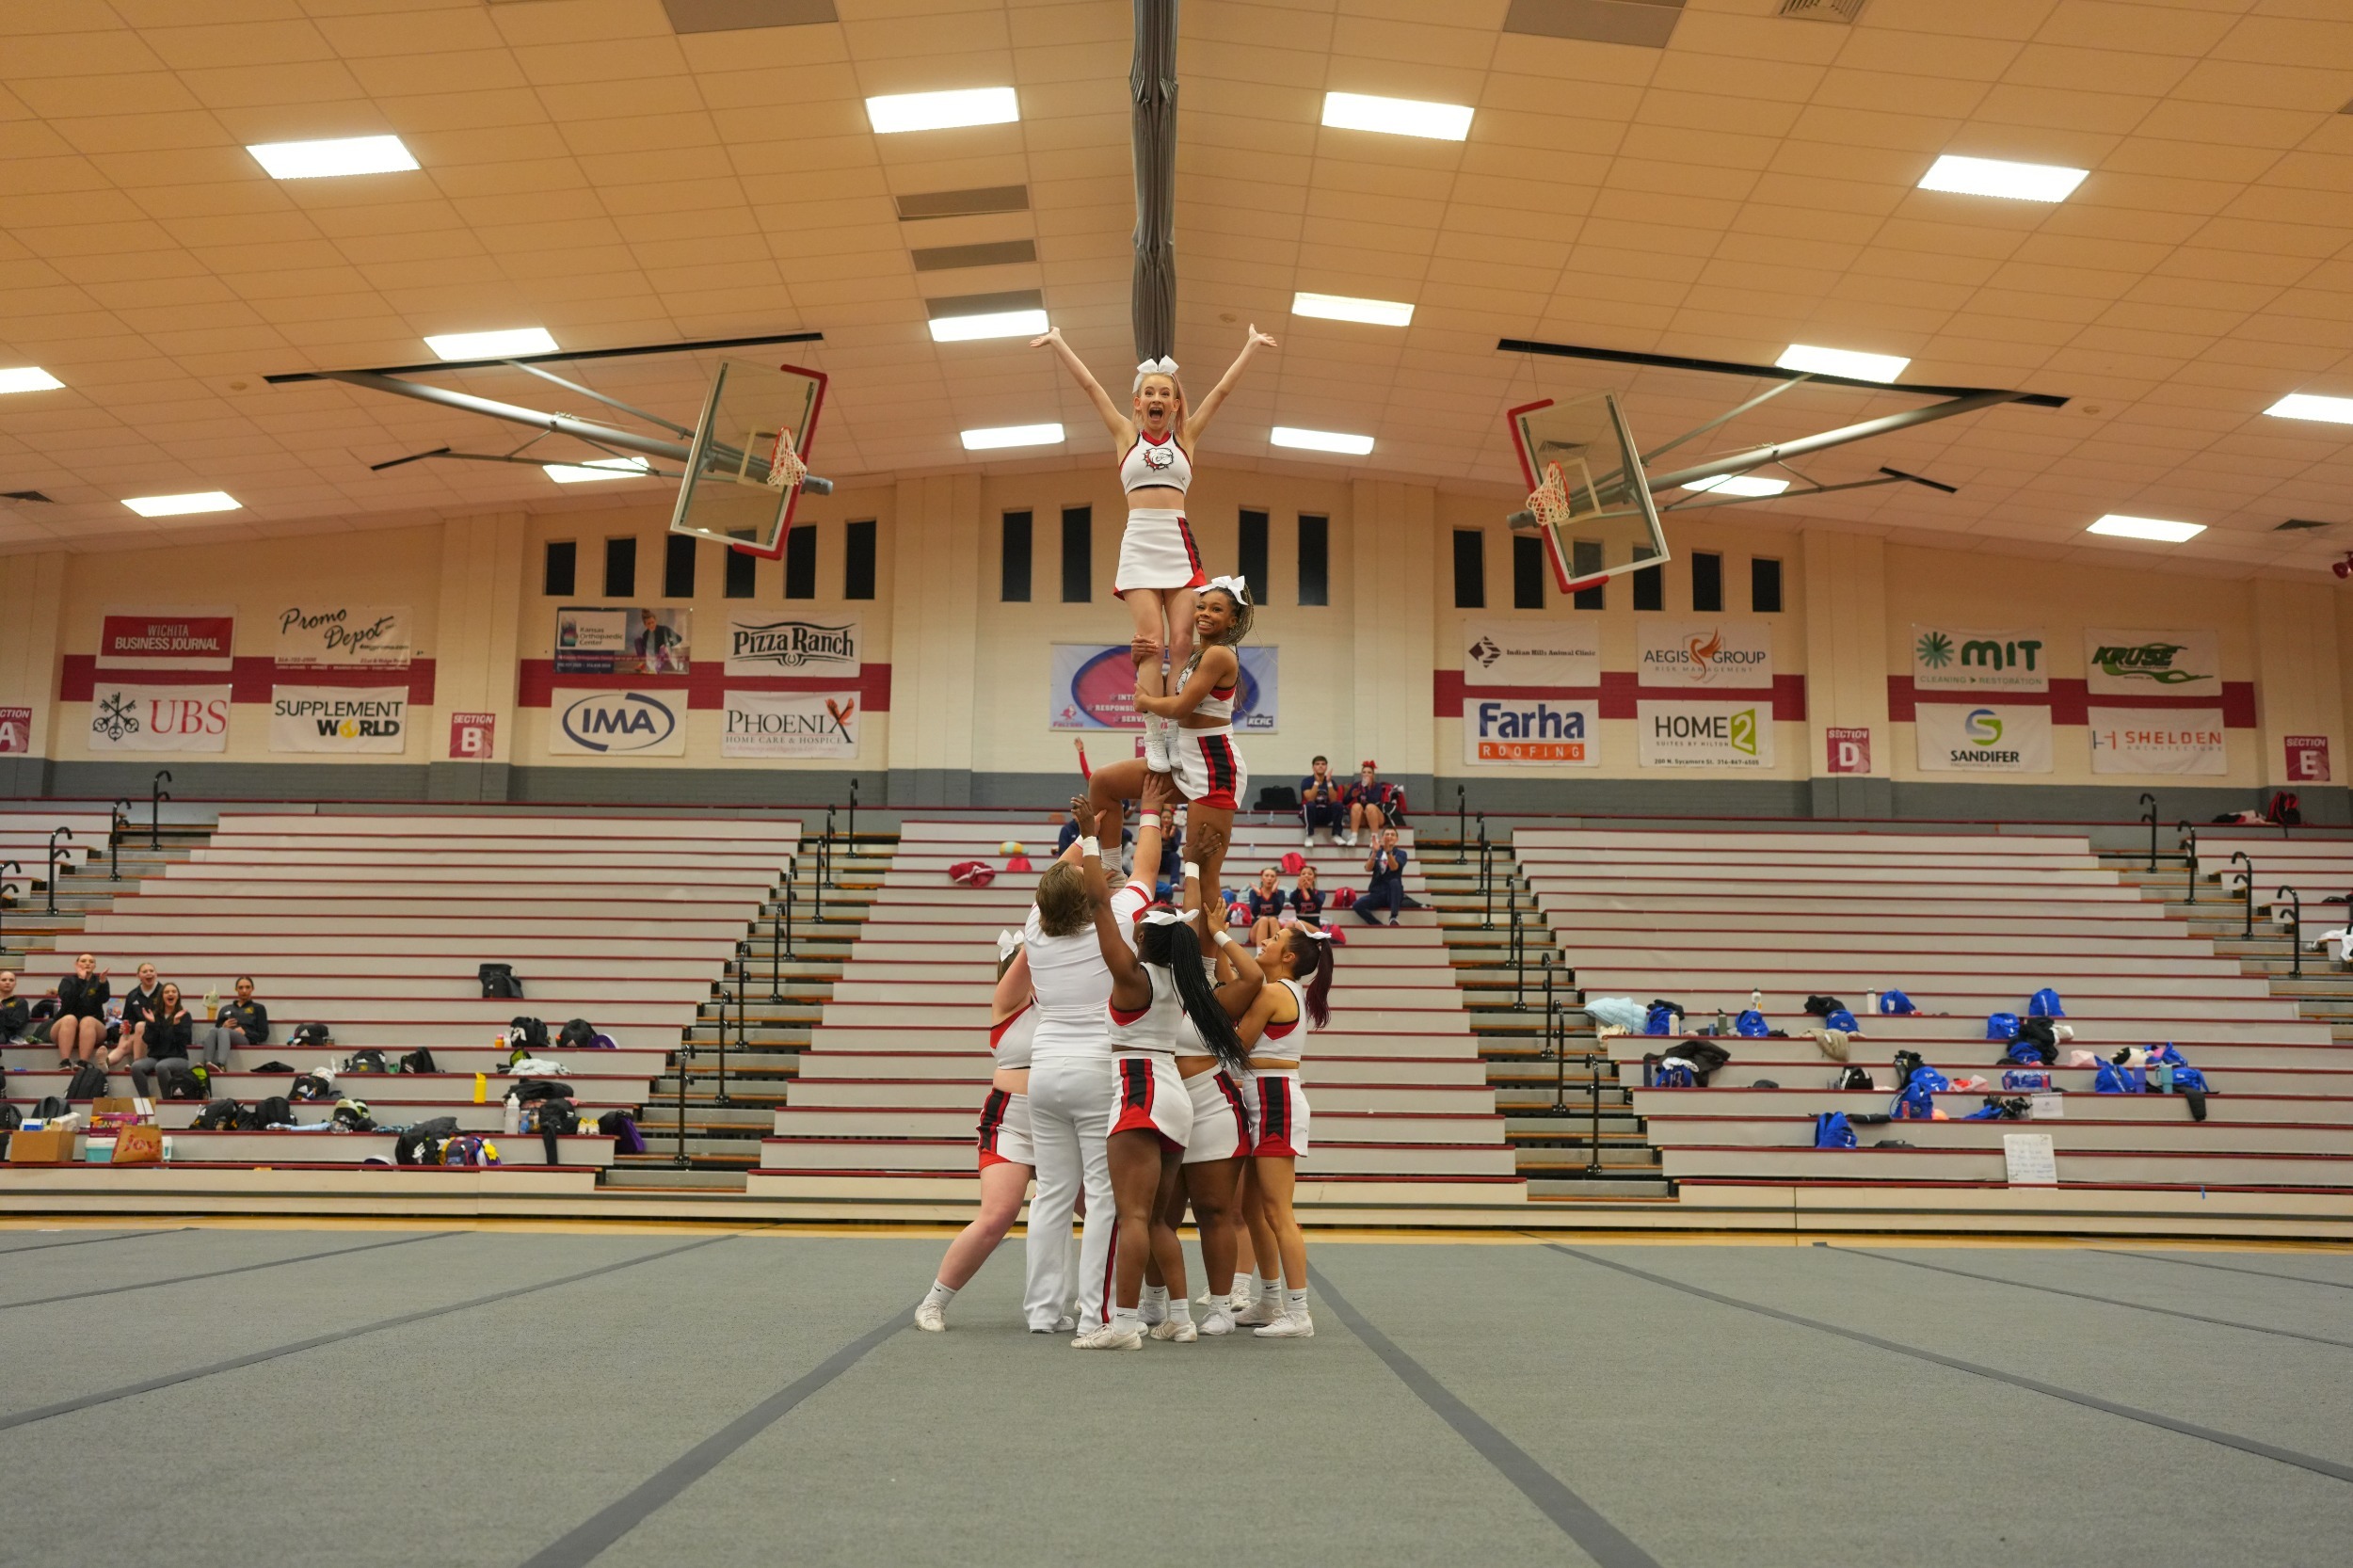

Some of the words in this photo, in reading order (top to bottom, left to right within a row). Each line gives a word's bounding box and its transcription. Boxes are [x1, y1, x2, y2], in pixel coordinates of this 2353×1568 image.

[280, 608, 347, 634] Promo
[148, 625, 189, 637] WICHITA
[324, 616, 394, 655] Depot
[580, 632, 623, 641] Orthopaedic
[115, 637, 169, 650] BUSINESS
[170, 638, 220, 650] JOURNAL
[733, 631, 789, 656] Pizza
[792, 627, 854, 657] Ranch
[1644, 650, 1689, 664] AEGIS
[1711, 650, 1766, 664] GROUP
[2091, 646, 2179, 666] KRUSE
[1979, 677, 2042, 685] RESTORATION
[0, 709, 30, 719] CTION
[150, 699, 228, 734] UBS
[275, 700, 404, 717] SUPPLEMENT
[453, 715, 494, 724] SECTION
[583, 708, 657, 734] IMA
[727, 699, 855, 744] PHOENIX
[1480, 702, 1585, 739] Farha
[0, 722, 17, 746] A
[316, 719, 401, 738] WORLD
[1828, 729, 1867, 739] SECTION
[2125, 730, 2222, 744] SHELDEN
[461, 728, 482, 752] B
[799, 736, 841, 744] HOSPICE
[2286, 738, 2326, 747] SECTION
[1482, 745, 1580, 758] ROOFING
[1839, 742, 1860, 767] D
[1950, 750, 2020, 762] SANDIFER
[2299, 750, 2319, 775] E
